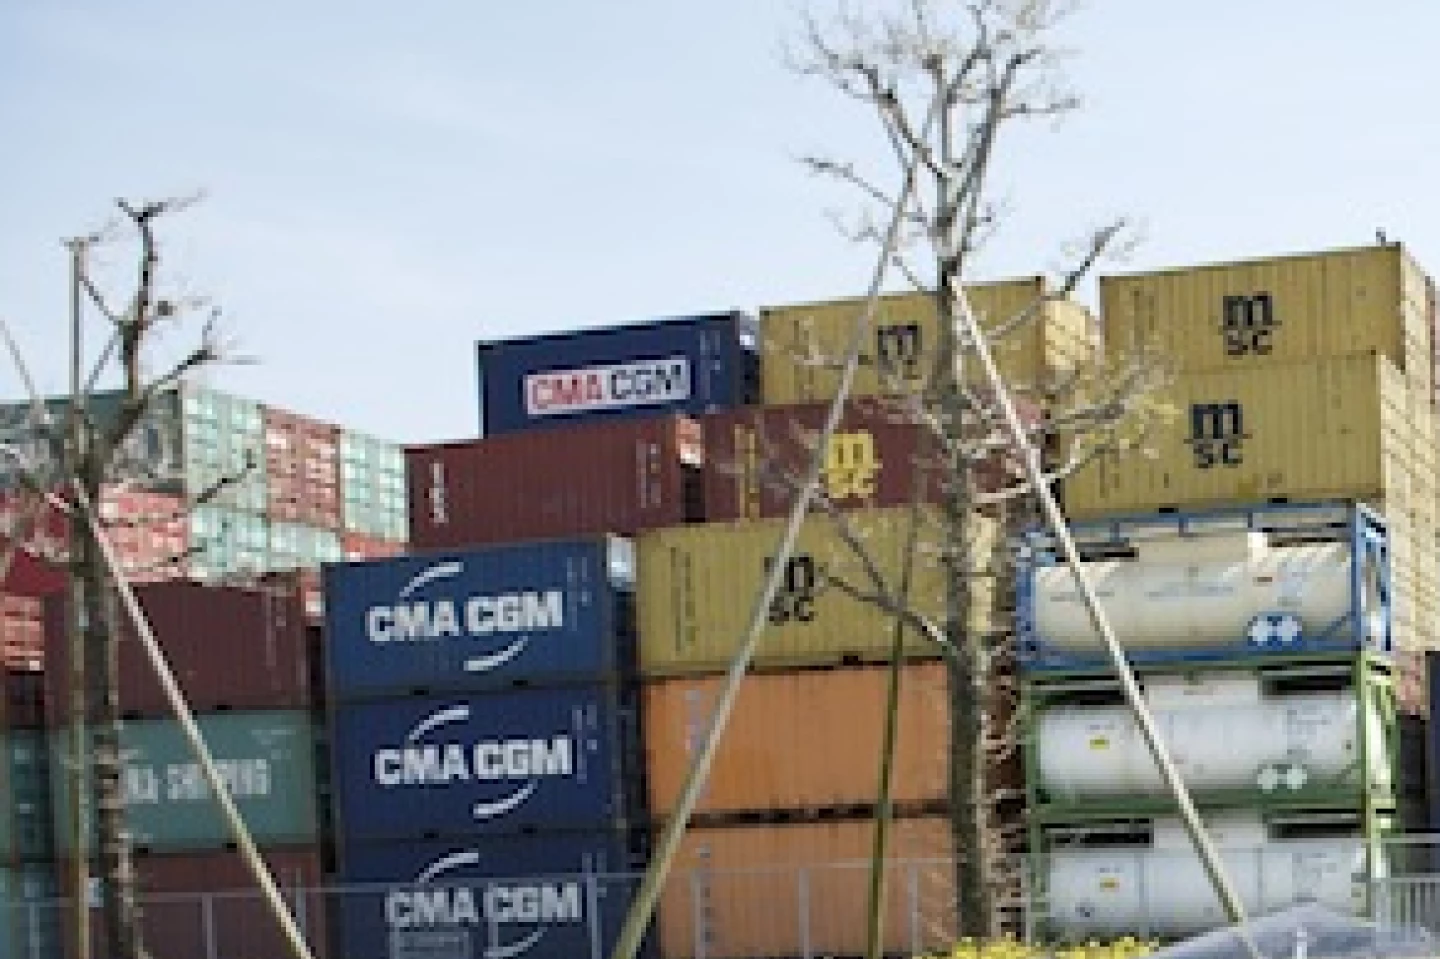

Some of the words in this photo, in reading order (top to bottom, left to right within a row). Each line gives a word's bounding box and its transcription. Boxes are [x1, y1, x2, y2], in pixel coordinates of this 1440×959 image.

[532, 373, 602, 409] CMA
[611, 364, 683, 400] CGM
[368, 601, 459, 641] CMA
[464, 591, 563, 632] CGM
[374, 744, 469, 785] CMA
[473, 735, 572, 781] CGM
[385, 886, 479, 928] CMA
[484, 883, 582, 923] CGM
